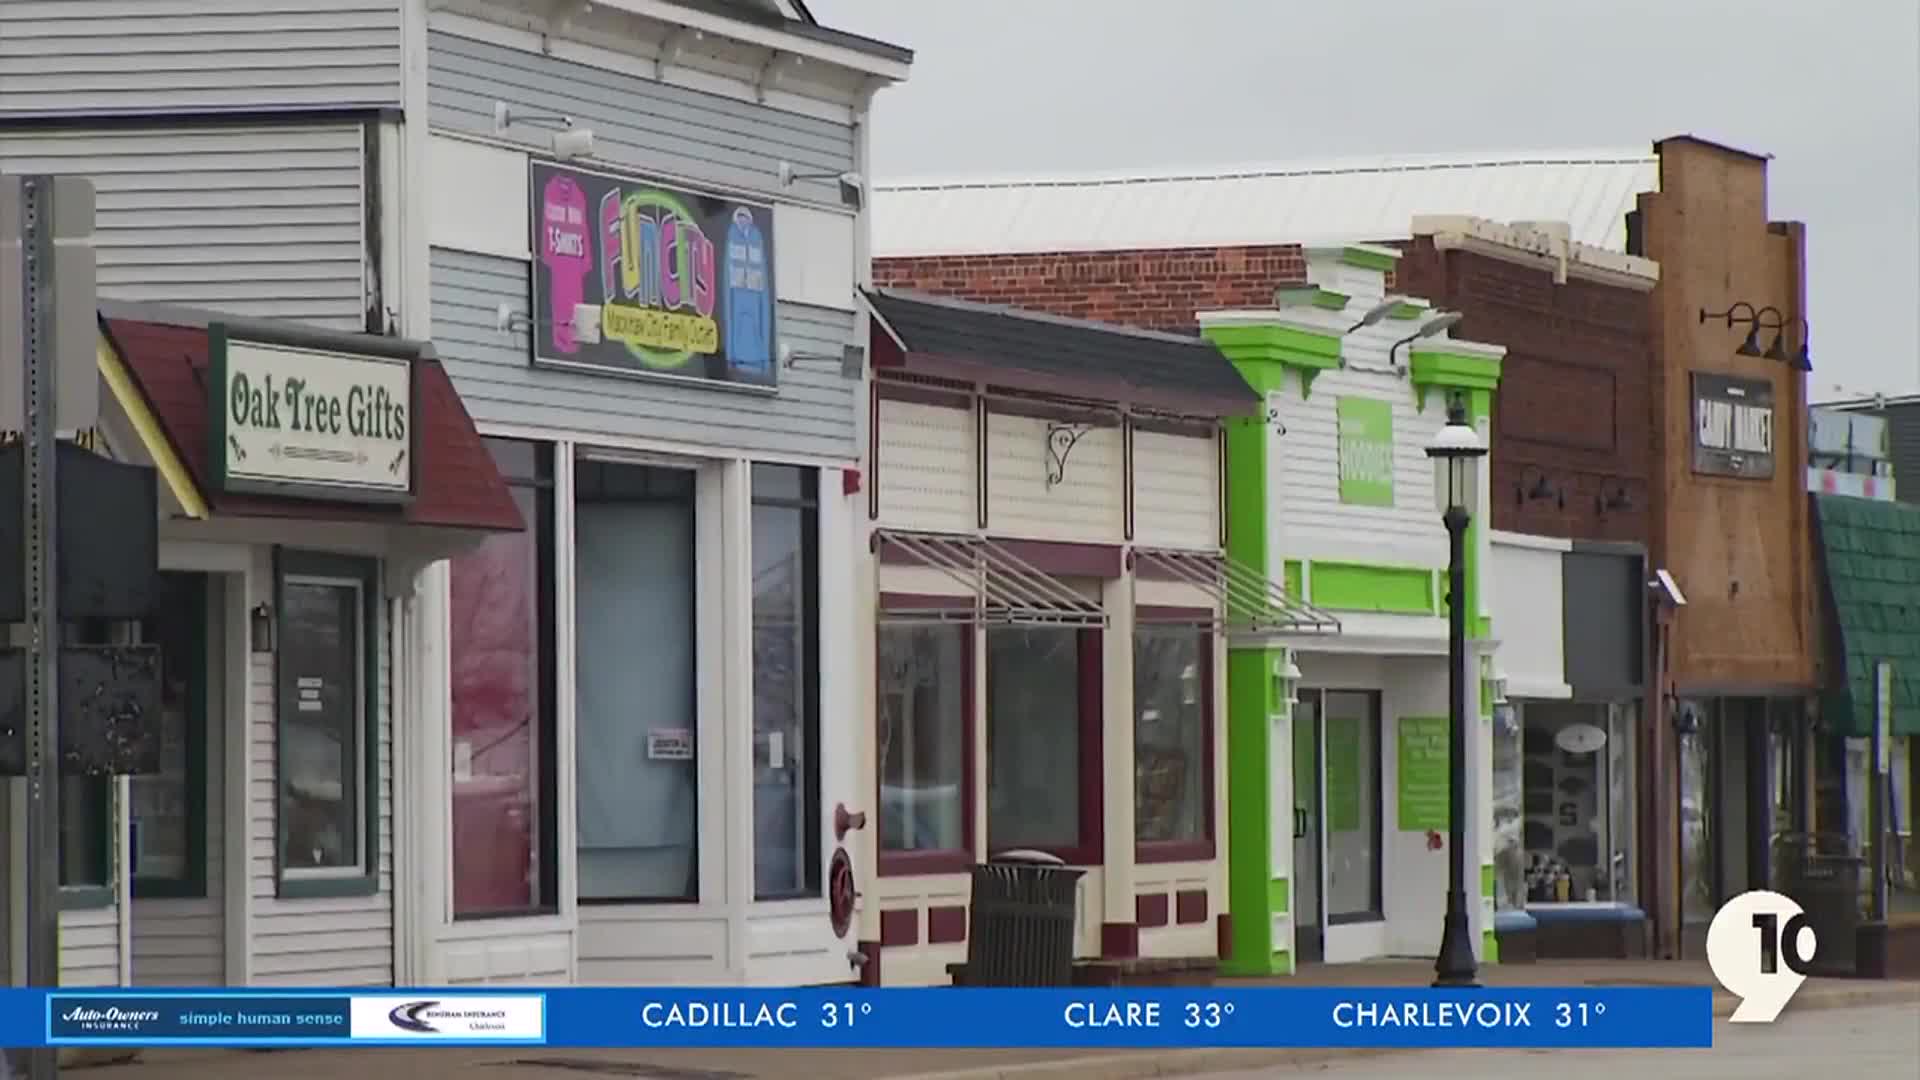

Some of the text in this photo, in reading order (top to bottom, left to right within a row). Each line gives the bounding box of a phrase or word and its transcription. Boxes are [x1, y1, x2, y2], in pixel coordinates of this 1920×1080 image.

[231, 370, 406, 441] Oak Tree Gifts
